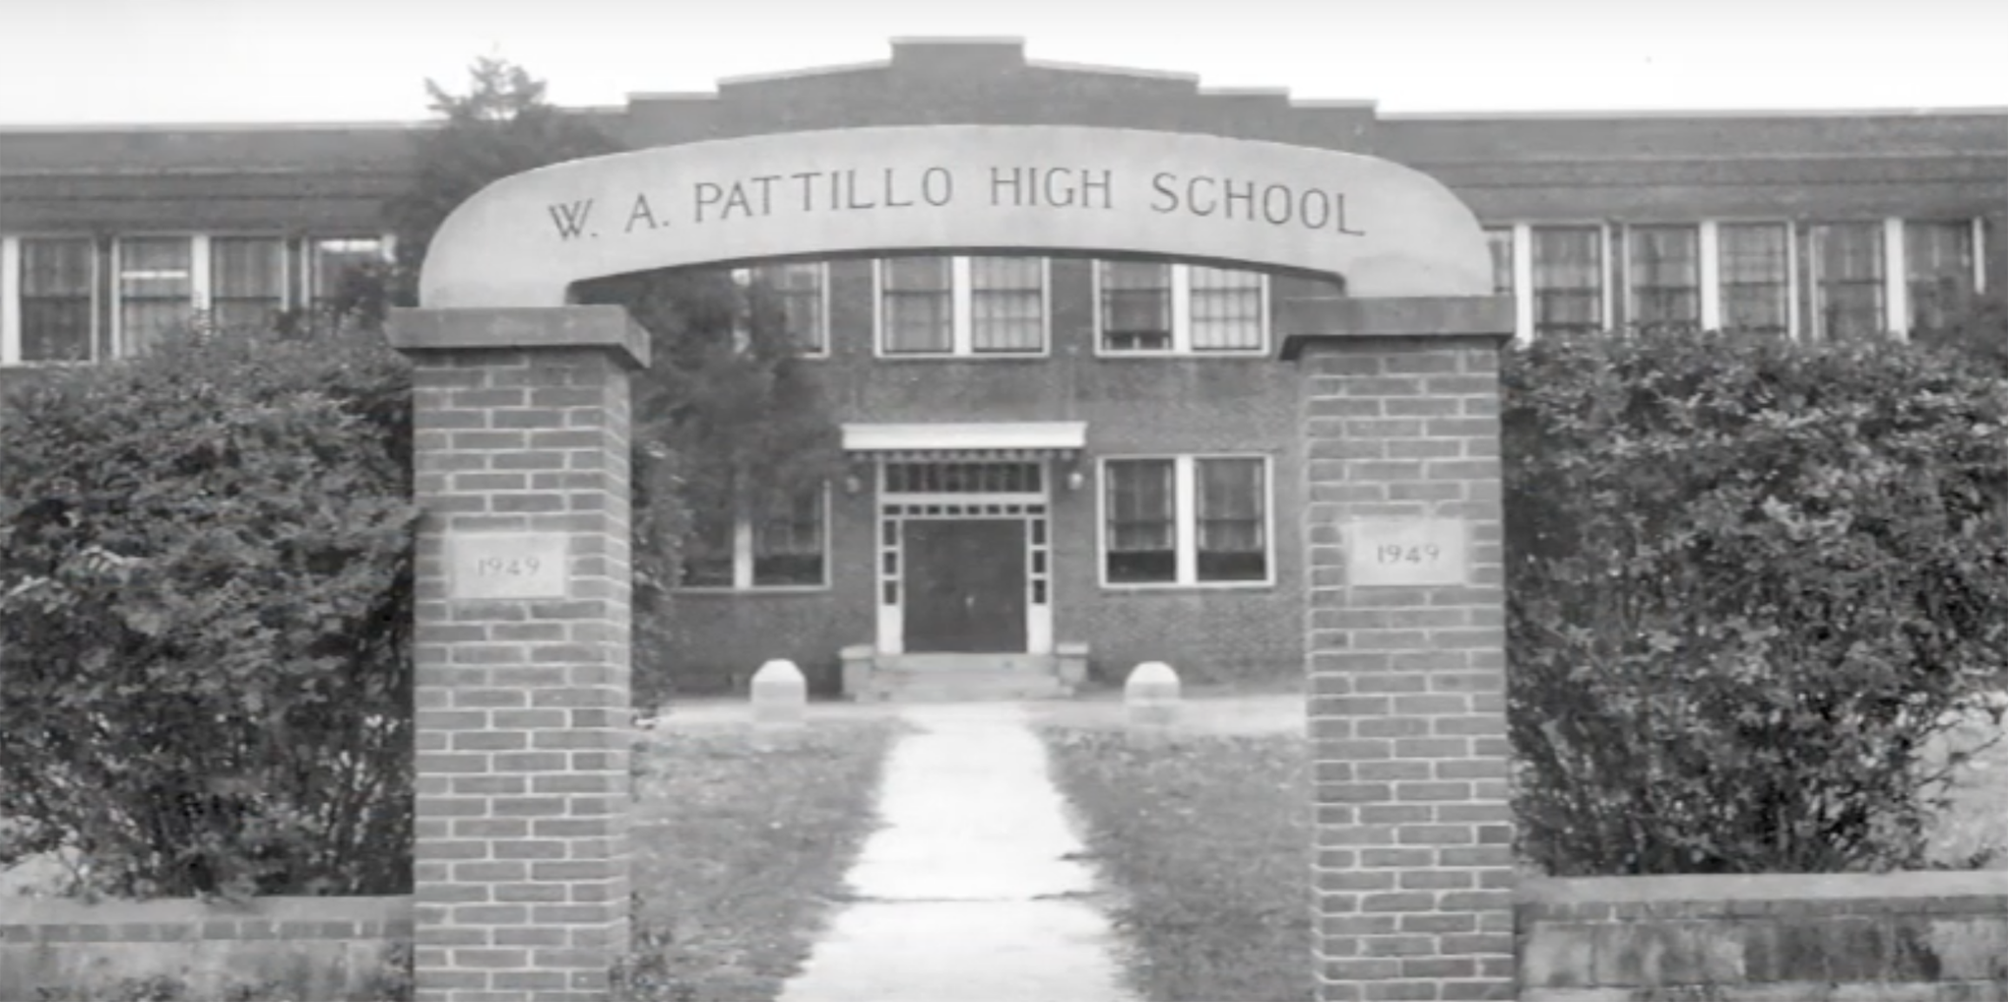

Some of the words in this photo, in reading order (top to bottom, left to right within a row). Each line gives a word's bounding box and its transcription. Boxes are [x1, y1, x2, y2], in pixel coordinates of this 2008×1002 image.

[548, 199, 598, 241] W.
[625, 193, 670, 232] A.
[694, 166, 954, 223] PATTILLO
[990, 167, 1113, 209] HIGH
[1150, 172, 1366, 237] SCHOOL
[1377, 543, 1440, 565] 1949
[477, 556, 541, 578] 1949
